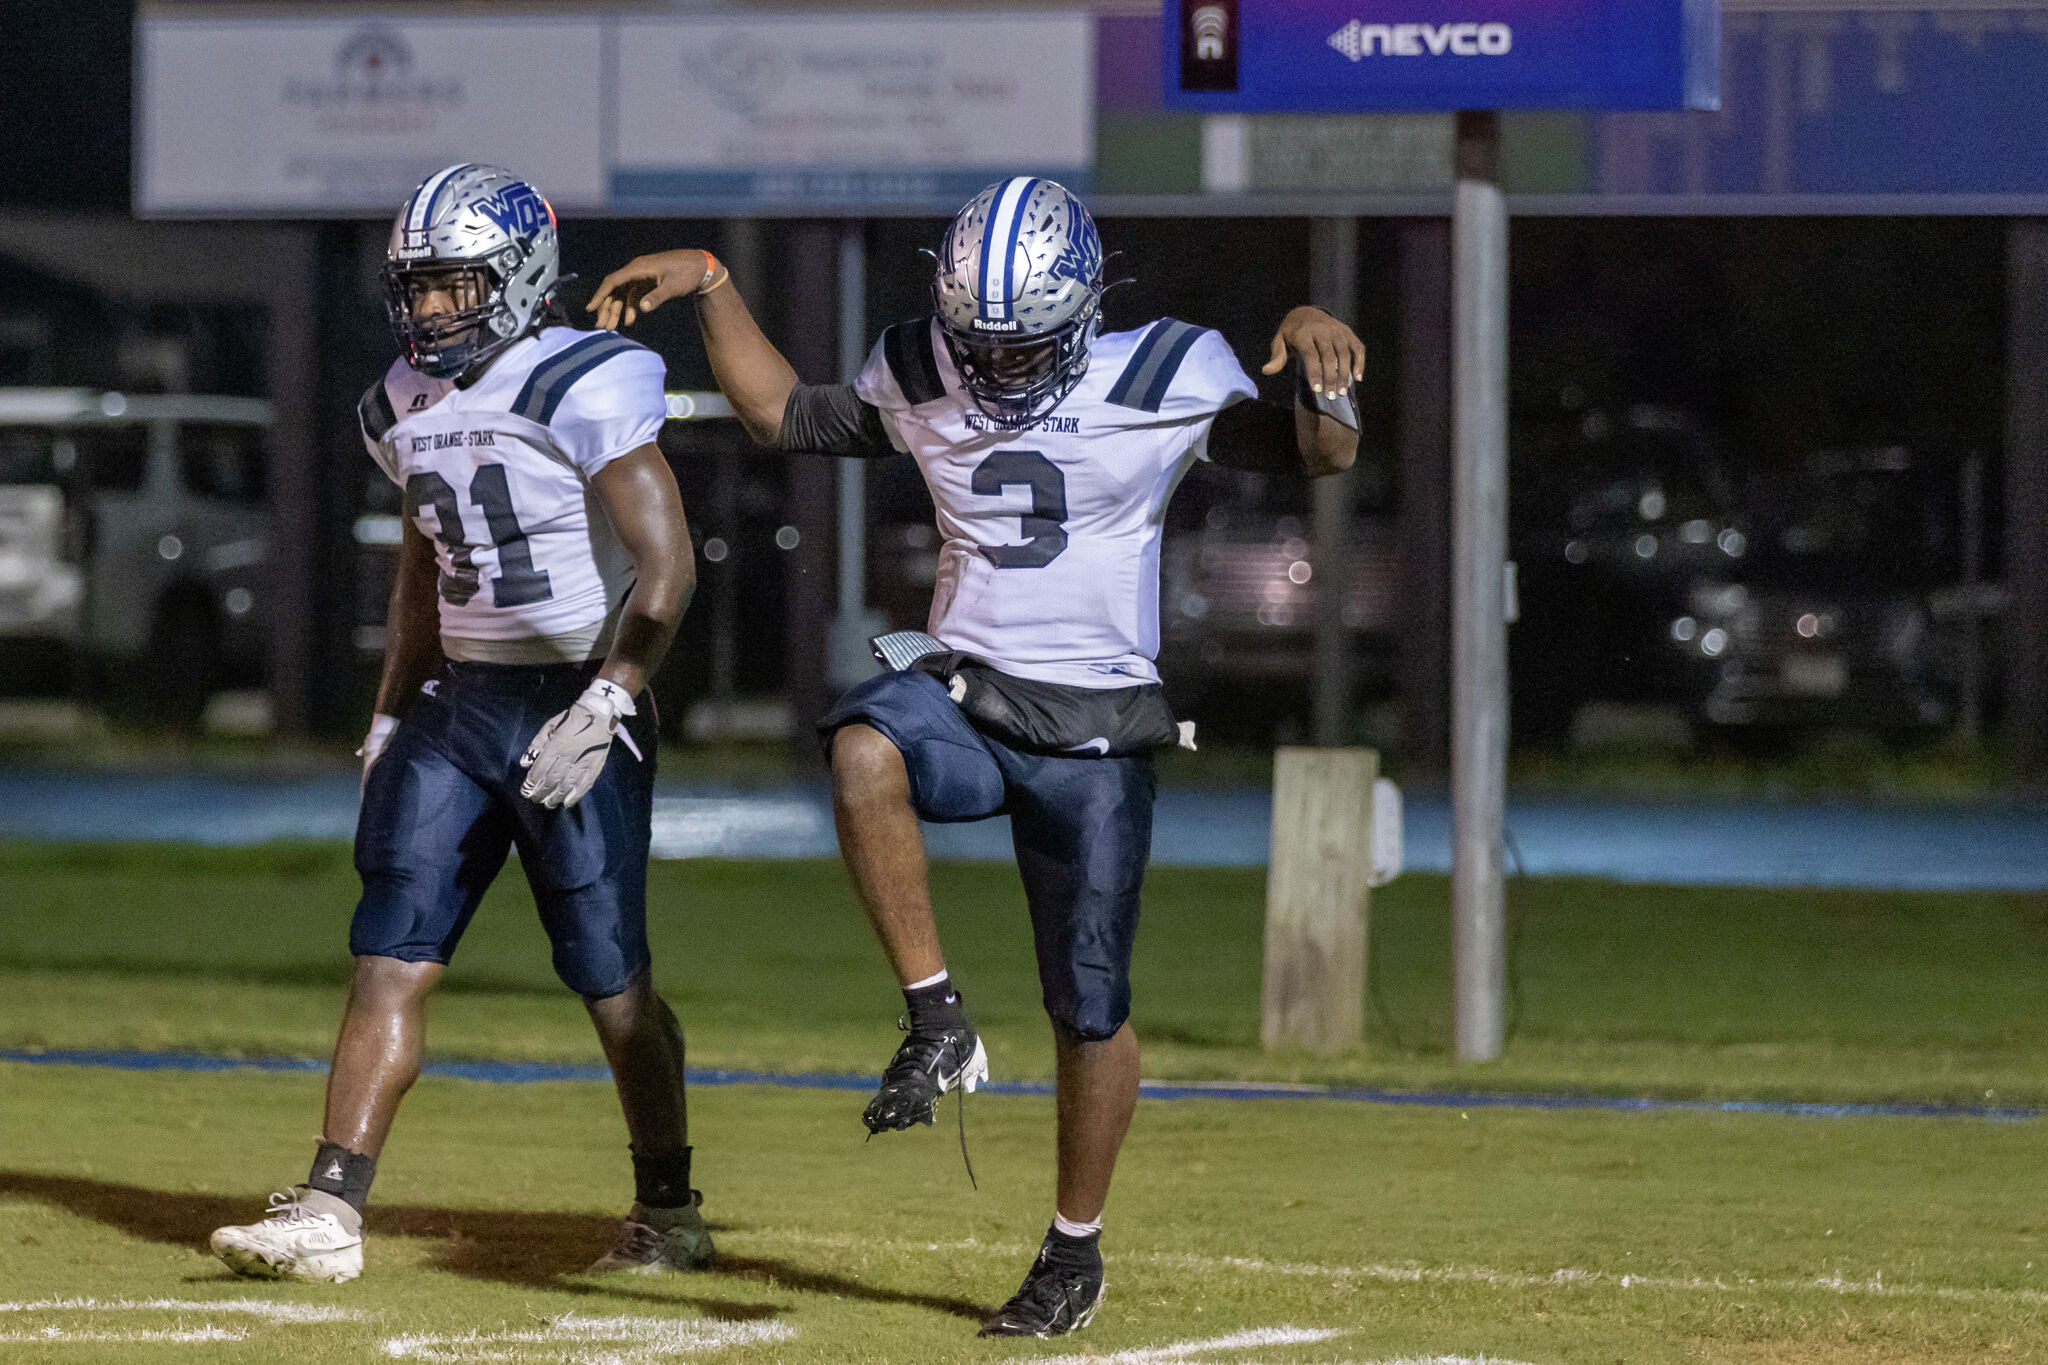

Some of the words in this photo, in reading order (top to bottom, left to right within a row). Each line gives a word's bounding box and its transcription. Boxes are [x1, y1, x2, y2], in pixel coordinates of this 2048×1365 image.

[1360, 23, 1512, 56] NEVCO
[973, 319, 1017, 331] Riddell
[965, 414, 989, 430] WEST
[1043, 417, 1080, 433] STARK
[411, 436, 432, 452] WEST
[434, 431, 463, 449] ORANGE
[469, 430, 495, 447] STARK
[972, 450, 1068, 570] 3
